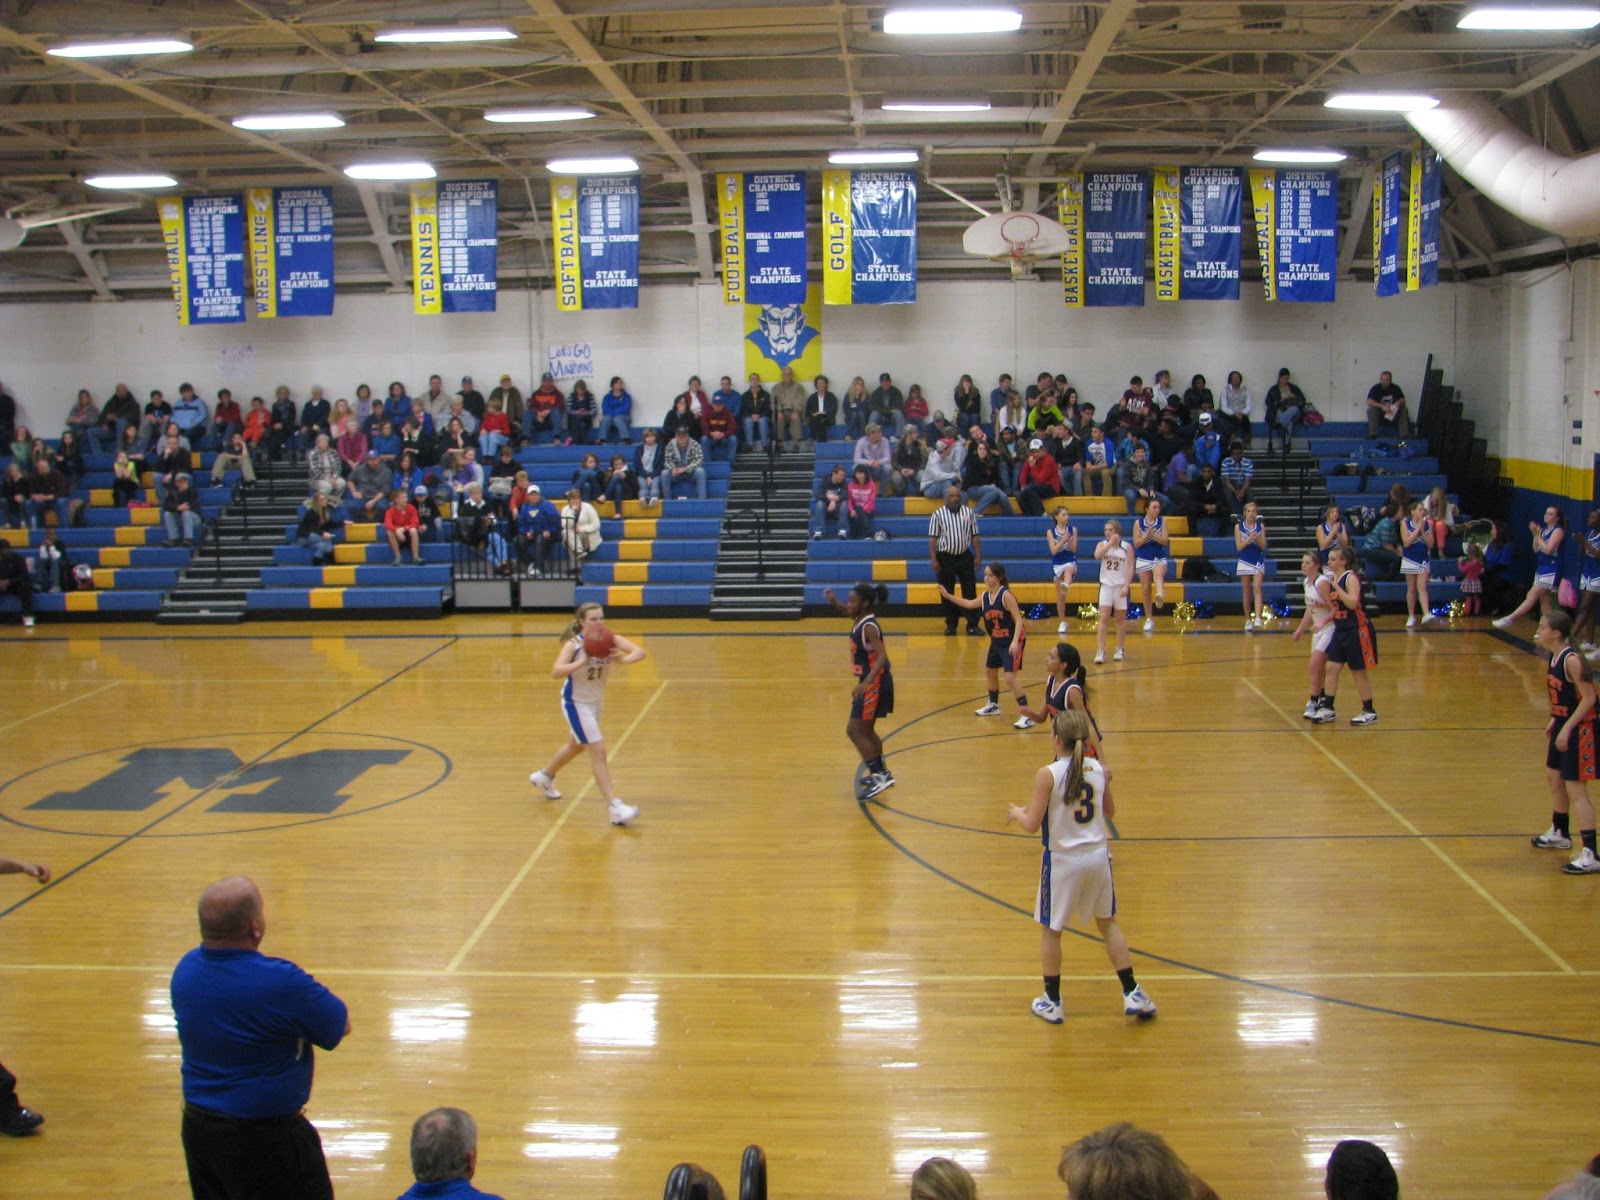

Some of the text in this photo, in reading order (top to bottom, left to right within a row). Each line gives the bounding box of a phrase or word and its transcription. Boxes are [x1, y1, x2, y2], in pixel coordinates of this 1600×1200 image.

[861, 172, 906, 180] DISTRICT
[1190, 168, 1234, 176] DISTRICT
[1286, 172, 1326, 180] DISTRICT
[586, 178, 631, 186] DISTRICT
[754, 174, 795, 184] DISTRICT
[1093, 174, 1138, 182] DISTRICT
[1184, 176, 1240, 185] CHAMPIONS
[446, 182, 490, 190] DISTRICT
[748, 183, 800, 192] CHAMPIONS
[1088, 182, 1143, 192] CHAMPIONS
[1280, 180, 1332, 189] CHAMPIONS
[281, 190, 324, 199] REGIONAL
[440, 190, 495, 200] CHAMPIONS
[582, 186, 636, 196] CHAMPIONS
[193, 197, 233, 206] DISTRICT
[278, 198, 328, 207] CHAMPIONS
[188, 205, 239, 214] CHAMPIONS
[774, 231, 804, 239] CHAMPIONS
[830, 212, 844, 270] GOLF
[725, 206, 740, 302] FOOTBALL
[1159, 204, 1174, 296] BASKETBALL
[560, 207, 576, 306] SOFTBALL
[1064, 210, 1078, 304] BASKETBALL
[254, 215, 269, 312] WRESTLING
[419, 222, 434, 306] TENNIS
[1196, 262, 1226, 270] STATE
[1289, 264, 1320, 272] STATE
[760, 267, 791, 276] STATE
[868, 264, 899, 273] STATE
[1101, 268, 1132, 276] STATE
[290, 272, 320, 280] STATE
[454, 274, 485, 282] STATE
[596, 270, 626, 279] STATE
[855, 273, 912, 281] CHAMPIONS
[1184, 270, 1239, 278] CHAMPIONS
[1278, 272, 1330, 280] CHAMPIONS
[280, 280, 329, 288] CHAMPIONS
[584, 279, 638, 288] CHAMPIONS
[750, 275, 802, 284] CHAMPIONS
[1088, 276, 1144, 284] CHAMPIONS
[442, 282, 496, 291] CHAMPIONS
[202, 288, 232, 297] STATE
[192, 296, 242, 306] CHAMPIONS
[1106, 560, 1120, 571] 22
[587, 666, 603, 680] 21
[1074, 782, 1094, 824] 3
